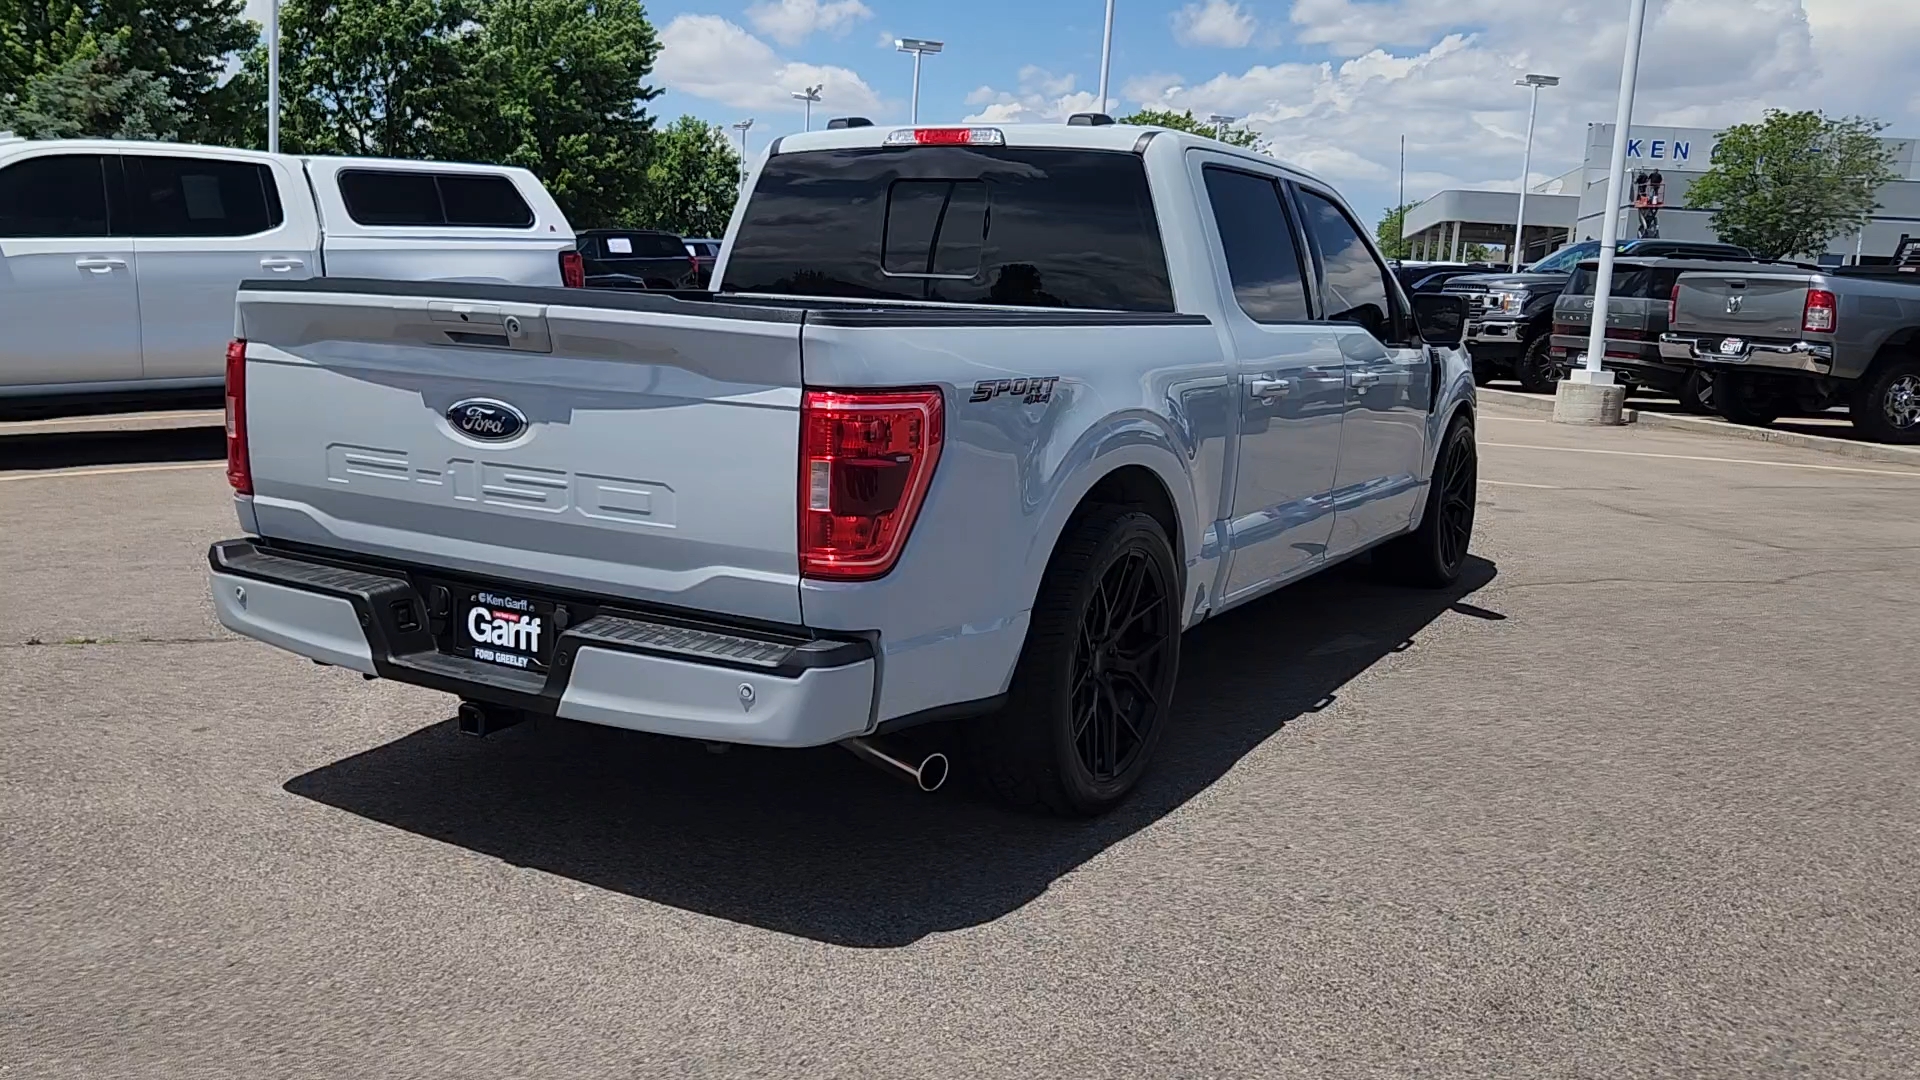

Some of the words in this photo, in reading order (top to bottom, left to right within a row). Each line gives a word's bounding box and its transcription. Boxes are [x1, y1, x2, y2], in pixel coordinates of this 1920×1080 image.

[1627, 139, 1690, 161] KEN
[1720, 339, 1744, 352] Garff
[969, 376, 1060, 403] SPORT
[462, 406, 506, 433] Ford
[325, 442, 677, 528] F-150
[486, 594, 504, 607] Ken
[504, 597, 528, 611] Garff
[468, 606, 541, 652] Garff
[474, 647, 494, 661] FORD
[495, 652, 529, 668] GREELEY
